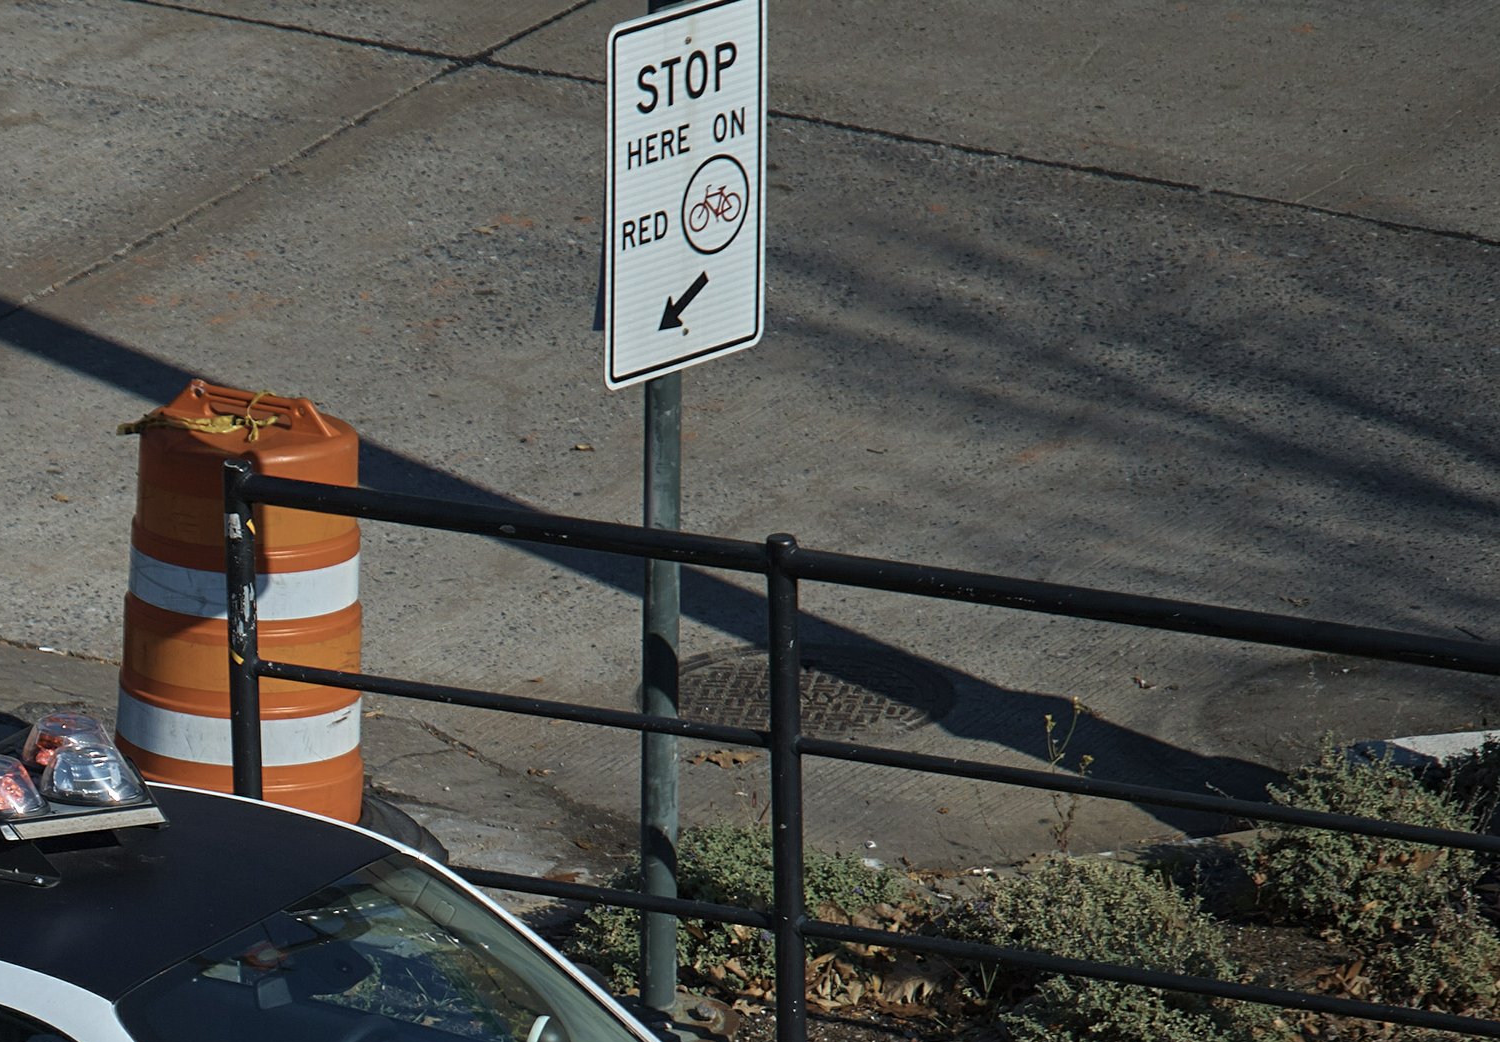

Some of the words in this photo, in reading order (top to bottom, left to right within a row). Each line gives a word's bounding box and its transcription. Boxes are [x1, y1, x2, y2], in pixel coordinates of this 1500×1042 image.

[636, 41, 738, 114] STOP
[627, 123, 690, 170] HERE
[713, 107, 745, 143] ON
[622, 210, 668, 251] RED
